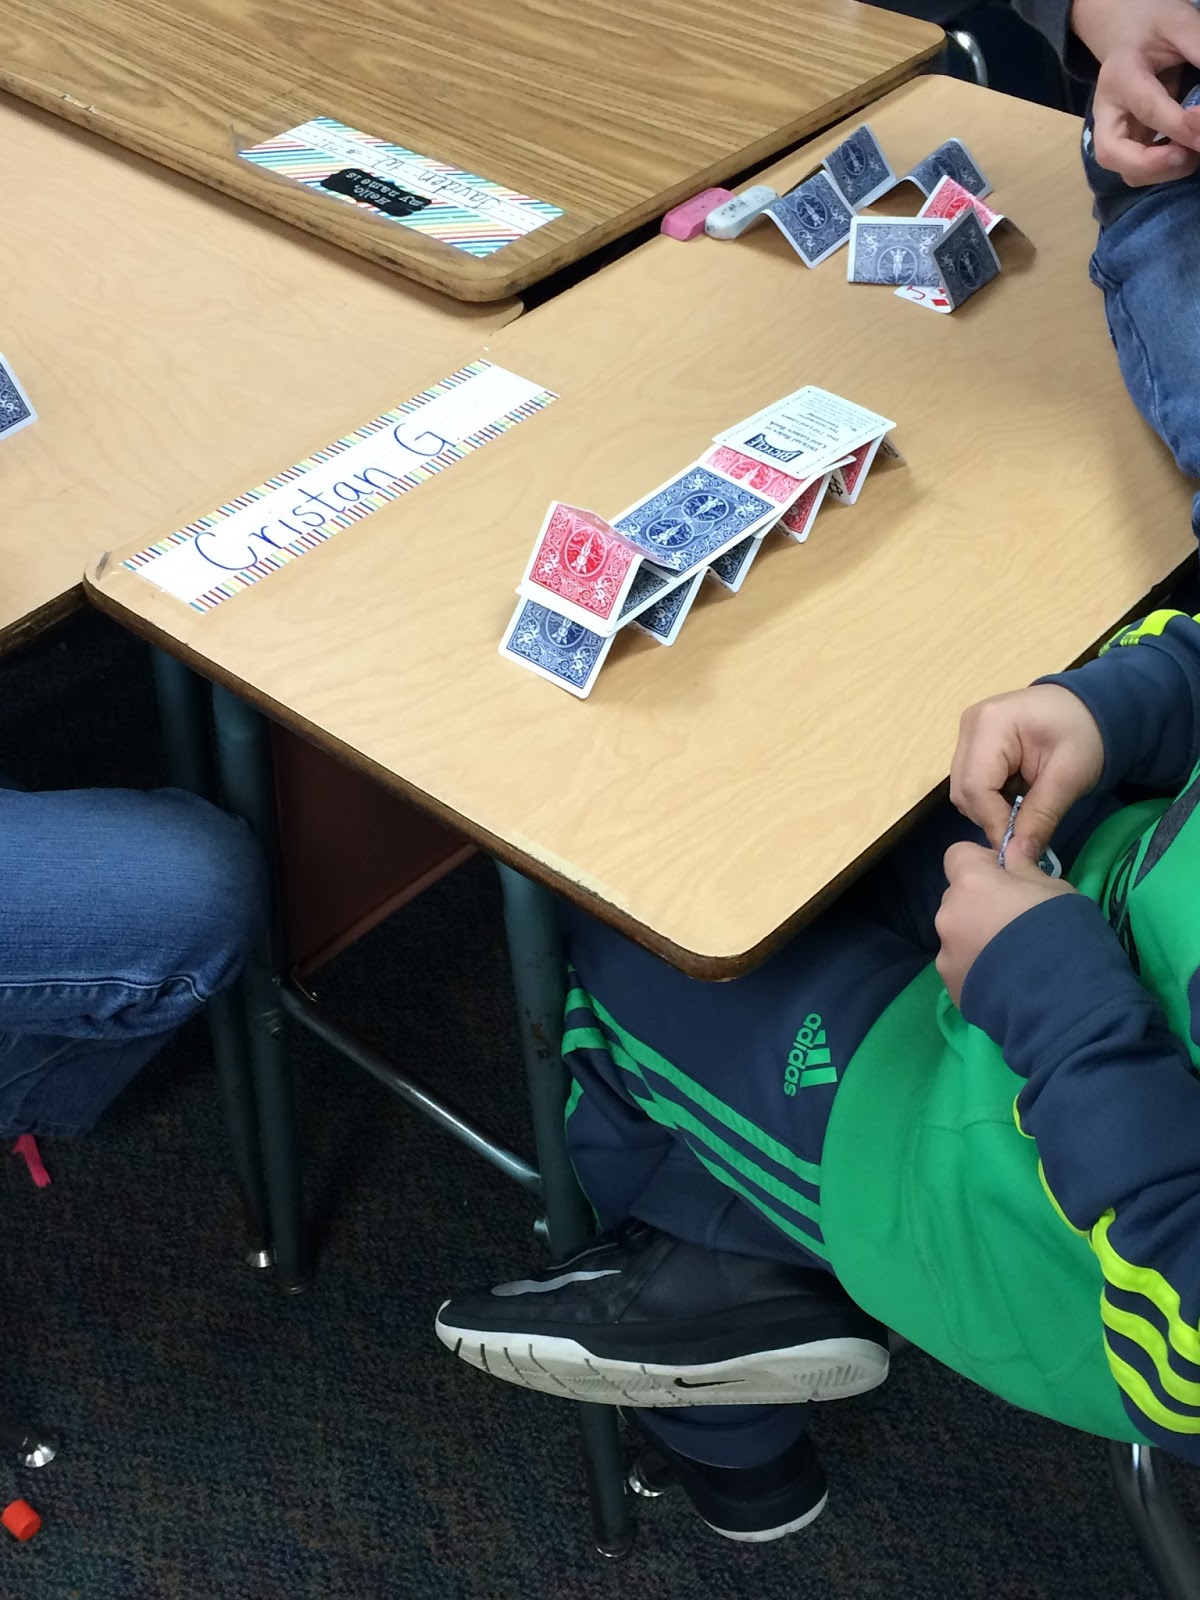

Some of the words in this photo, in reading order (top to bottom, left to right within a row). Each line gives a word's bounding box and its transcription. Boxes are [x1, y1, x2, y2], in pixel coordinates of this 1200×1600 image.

[345, 172, 362, 180] is
[353, 184, 392, 206] Hello,
[359, 178, 402, 197] name
[399, 194, 426, 206] my
[743, 434, 803, 462] BICYCLE
[195, 467, 400, 571] Cristan
[783, 1013, 822, 1097] adidas
